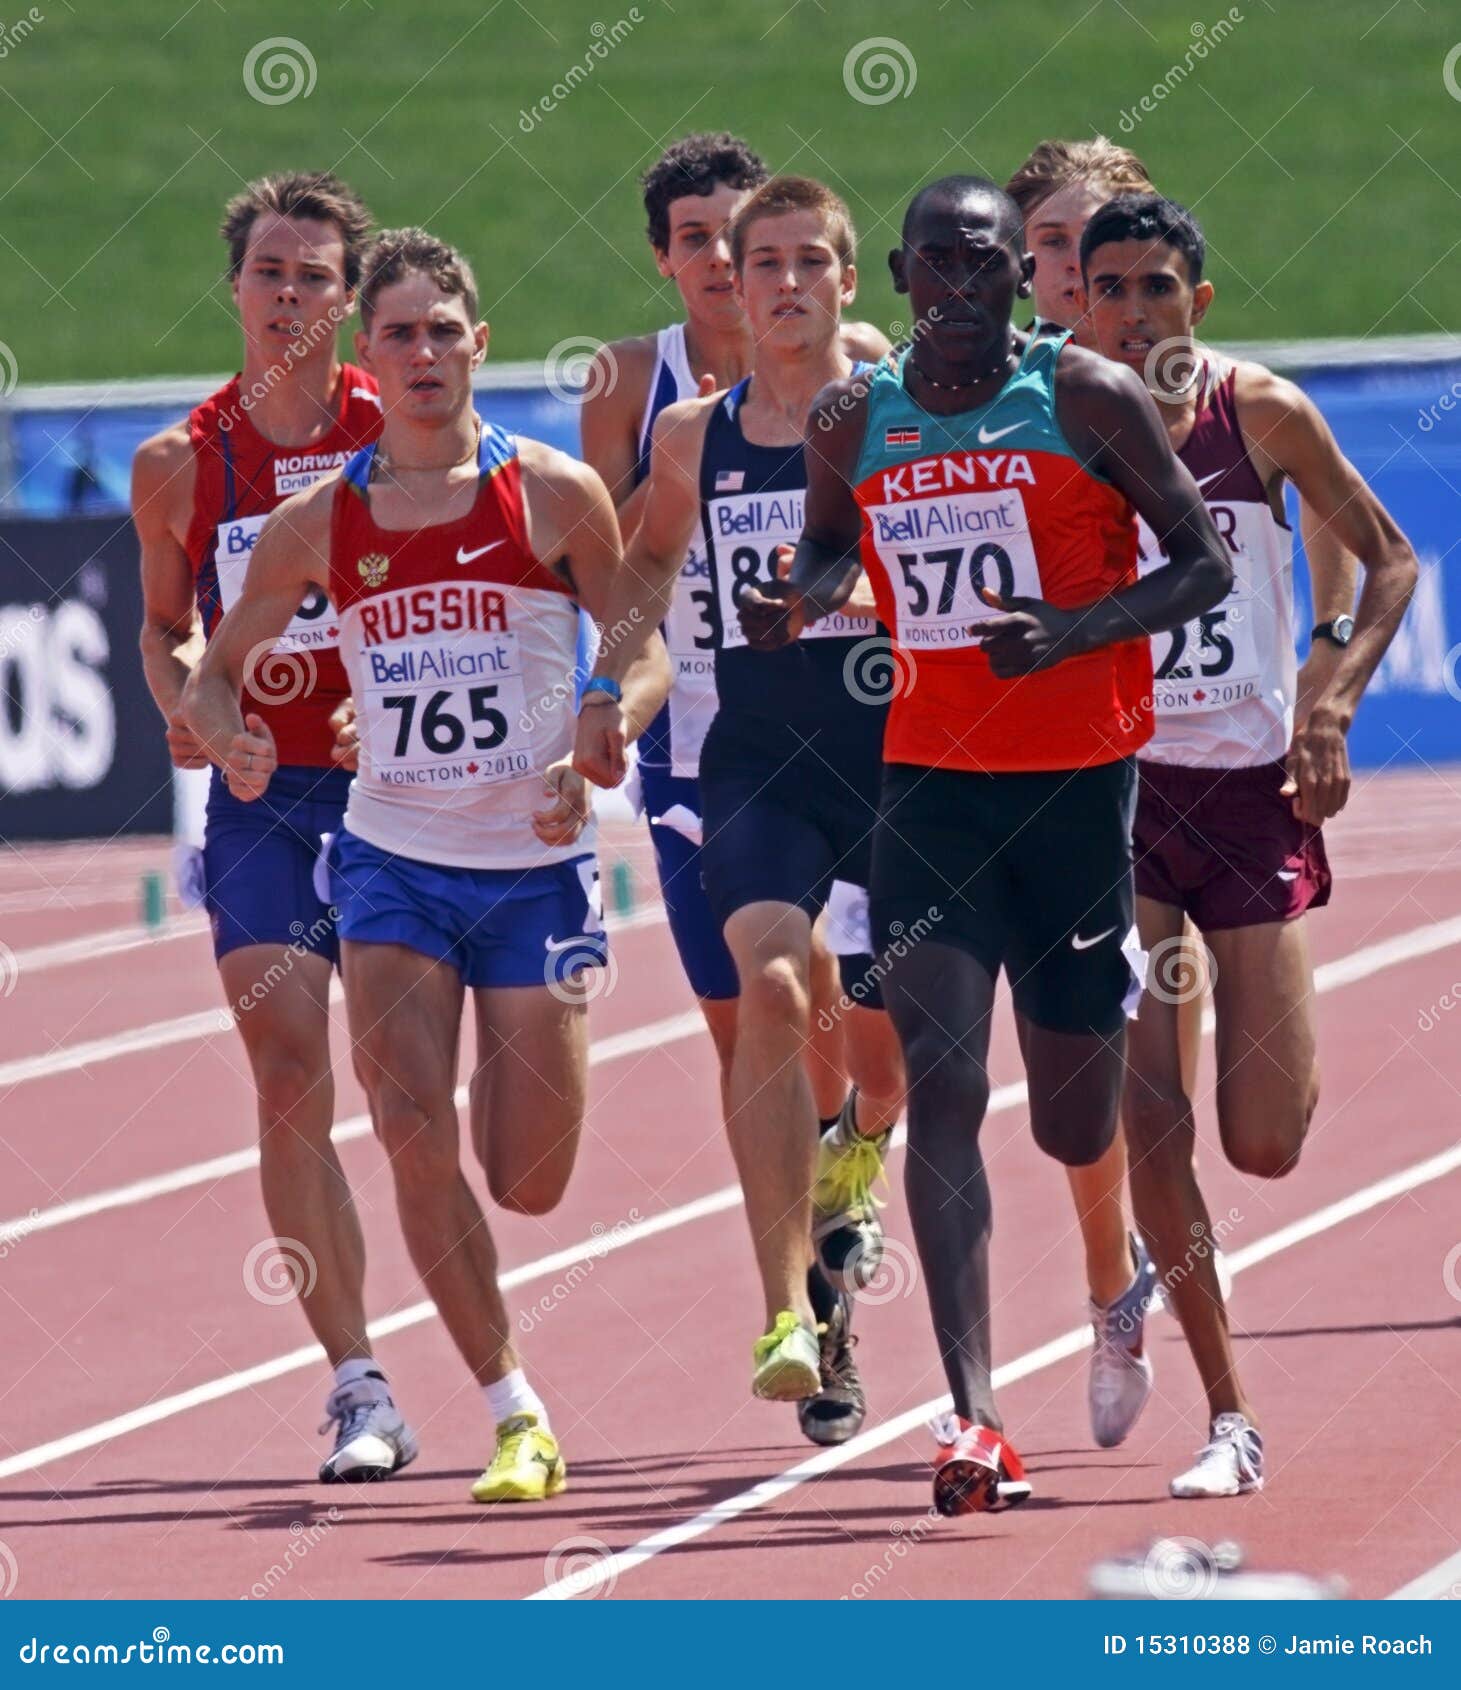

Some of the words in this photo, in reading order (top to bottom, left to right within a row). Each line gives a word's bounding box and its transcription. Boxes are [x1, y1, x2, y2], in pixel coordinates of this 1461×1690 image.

[274, 452, 358, 475] NORWAY
[883, 455, 1037, 503] KENYA
[717, 500, 803, 536] BellAli
[897, 542, 1015, 618] 570
[359, 587, 508, 648] RUSSIA
[820, 616, 869, 633] 2010
[370, 645, 511, 684] BellAliant
[1209, 682, 1255, 705] 2010
[382, 685, 509, 758] 765
[380, 765, 464, 785] MONCTON
[483, 754, 529, 777] 2010
